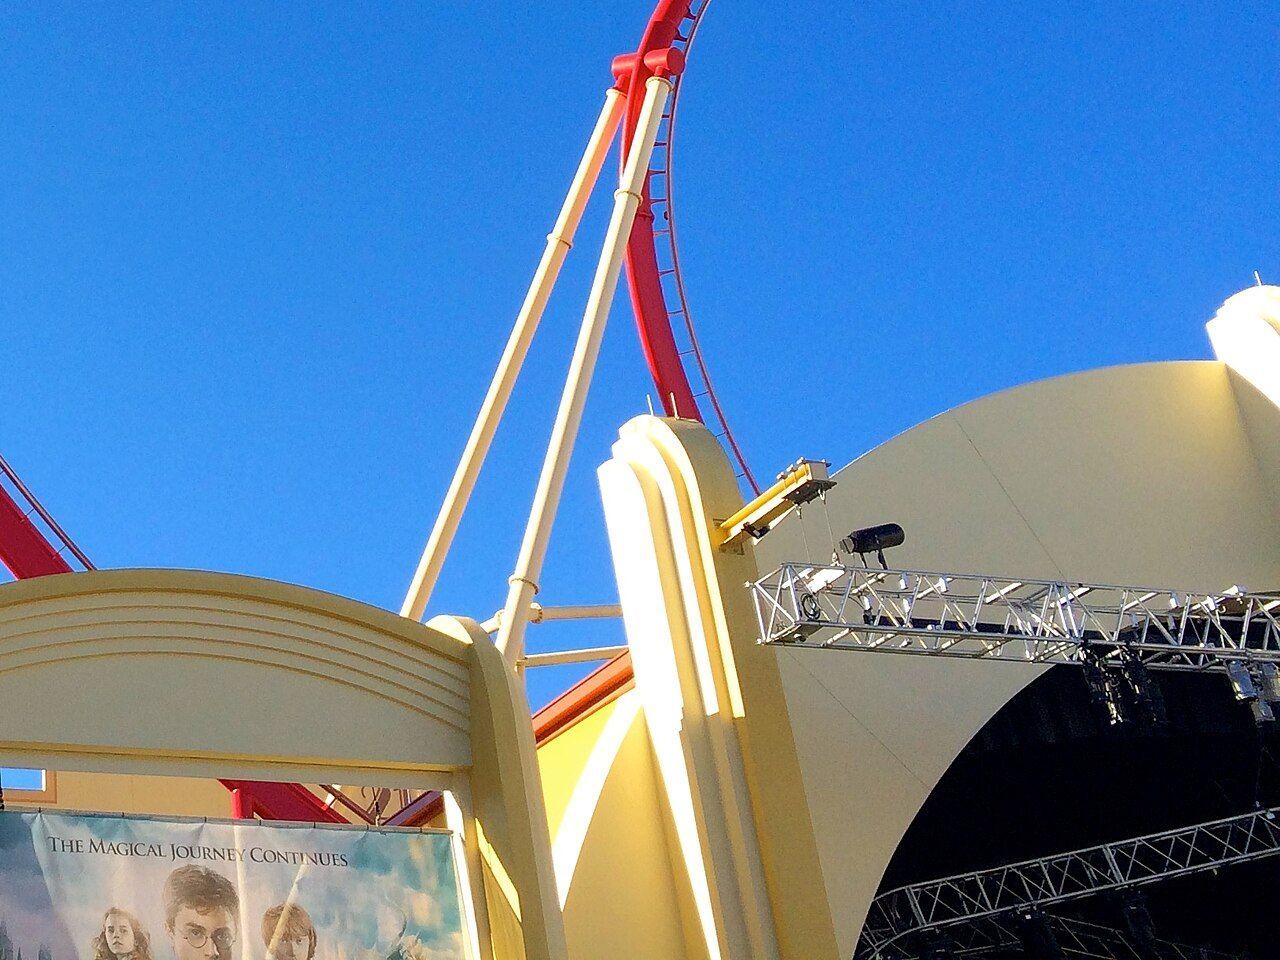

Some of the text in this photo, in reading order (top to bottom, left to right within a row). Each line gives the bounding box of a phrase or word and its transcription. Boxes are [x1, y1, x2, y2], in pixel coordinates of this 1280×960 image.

[47, 836, 349, 867] THE MAGICAL JOURNEY CONTINUES
